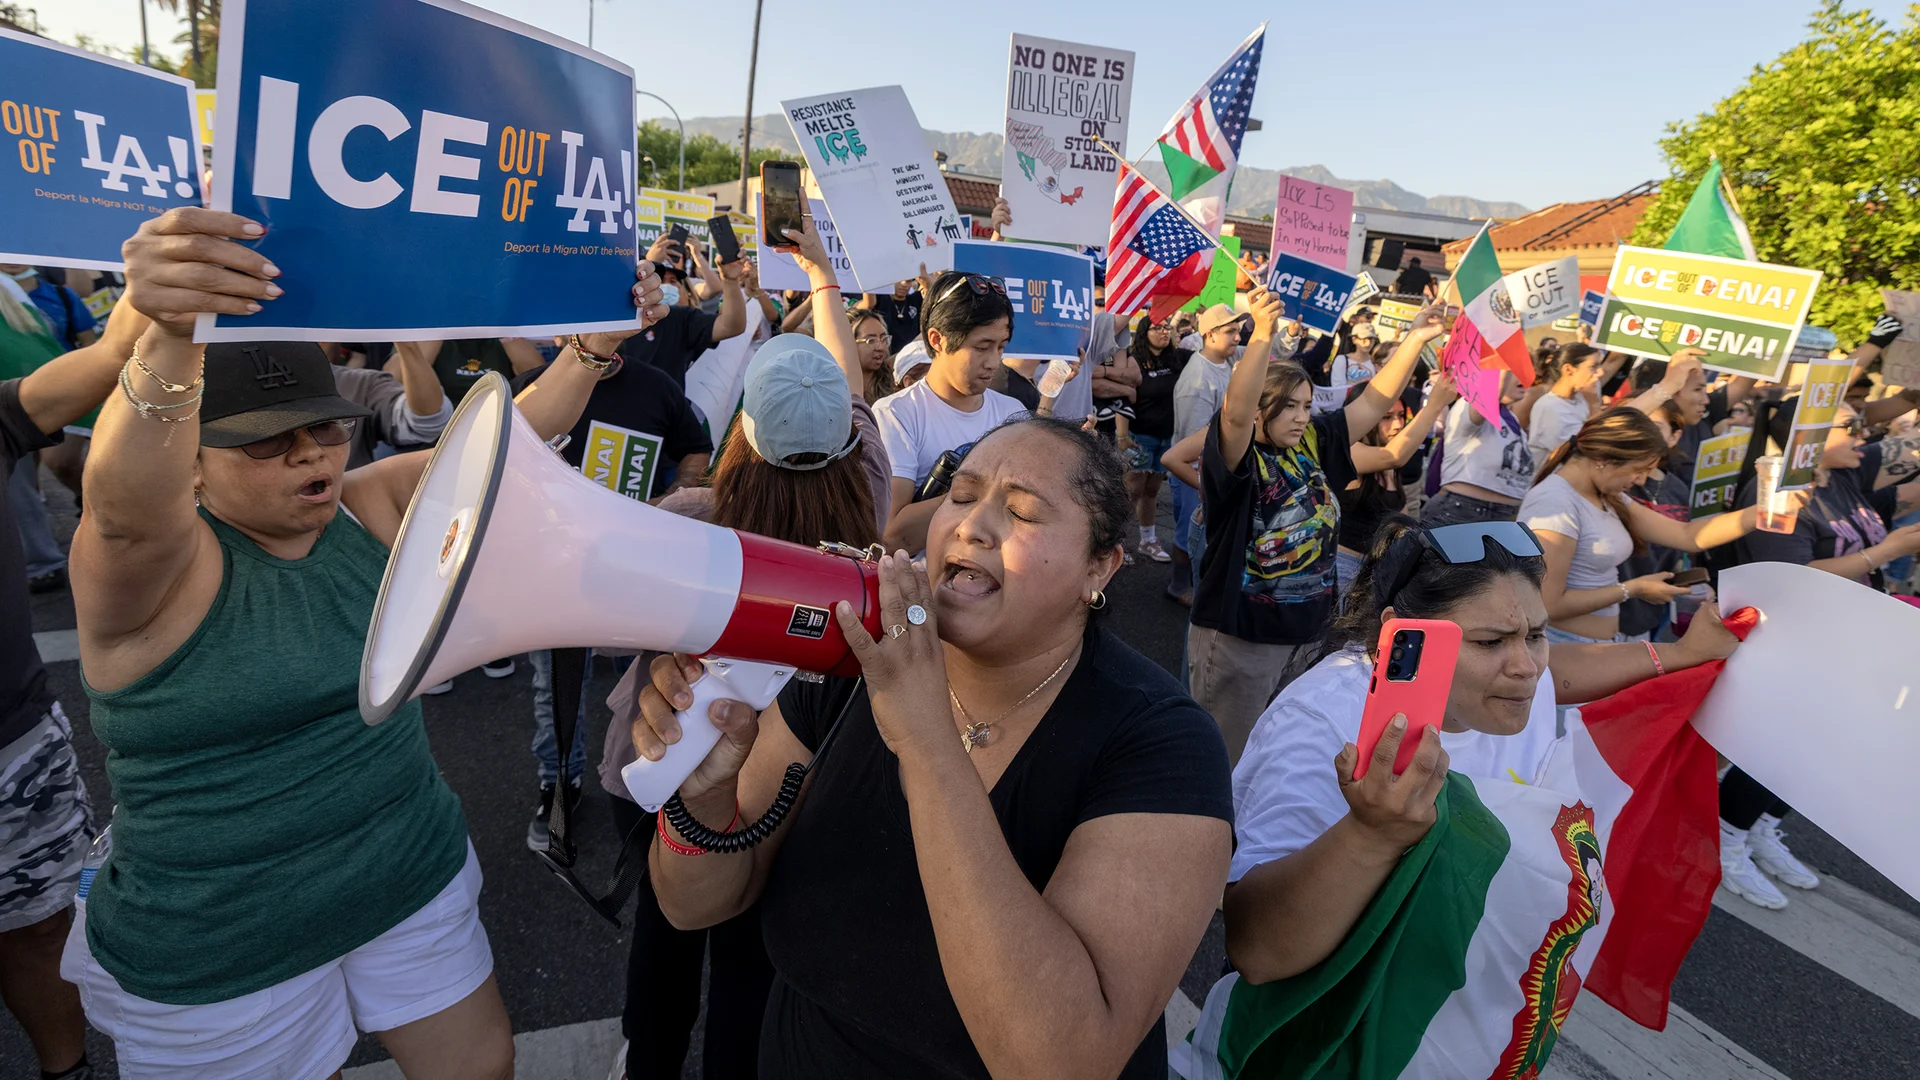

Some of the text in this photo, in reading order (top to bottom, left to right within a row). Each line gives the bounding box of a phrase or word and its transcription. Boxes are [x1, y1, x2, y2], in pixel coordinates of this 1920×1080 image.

[1014, 45, 1125, 81] NO ONE IS
[1010, 70, 1121, 123] ILLEGAL
[2, 100, 60, 142] OUT
[791, 97, 856, 122] RESISTANCE
[805, 113, 855, 135] MELTS
[1081, 119, 1106, 138] ON
[19, 139, 55, 175] OF
[74, 110, 194, 199] LA!
[252, 75, 489, 218] ICE
[499, 125, 551, 177] OUT
[814, 128, 867, 166] ICE
[1064, 136, 1120, 154] STOLEN
[892, 163, 920, 175] THE ONLY
[1070, 152, 1117, 173] LAND
[555, 130, 633, 234] LA!
[895, 174, 925, 185] MINORITY
[34, 188, 76, 202] Deport
[79, 194, 89, 204] la
[91, 196, 121, 209] Migra
[123, 202, 145, 212] NOT
[501, 177, 537, 223] OF
[902, 193, 938, 207] AMERICA IS
[902, 203, 945, 219] BILLIONAIRES
[504, 241, 542, 256] Deport
[542, 243, 551, 254] la
[553, 243, 578, 257] Migra
[580, 246, 598, 256] NOT
[601, 246, 612, 256] the
[1027, 279, 1048, 297] OUT
[1268, 270, 1305, 298] ICE
[1523, 267, 1559, 292] ICE
[1624, 265, 1678, 291] ICE
[1677, 282, 1692, 293] OF
[1678, 272, 1699, 283] OUT
[1031, 297, 1045, 314] OF
[1052, 279, 1091, 321] LA!
[1314, 283, 1348, 312] LA!
[1527, 286, 1564, 309] OUT
[1695, 275, 1798, 311] DENA!
[1609, 312, 1663, 340] ICE
[1661, 320, 1683, 333] OUT
[1677, 324, 1780, 361] DENA!
[242, 345, 298, 390] LA
[1806, 382, 1835, 408] ICE
[1701, 448, 1723, 470] ICE
[1791, 442, 1819, 470] ICE
[1694, 487, 1718, 508] ICE
